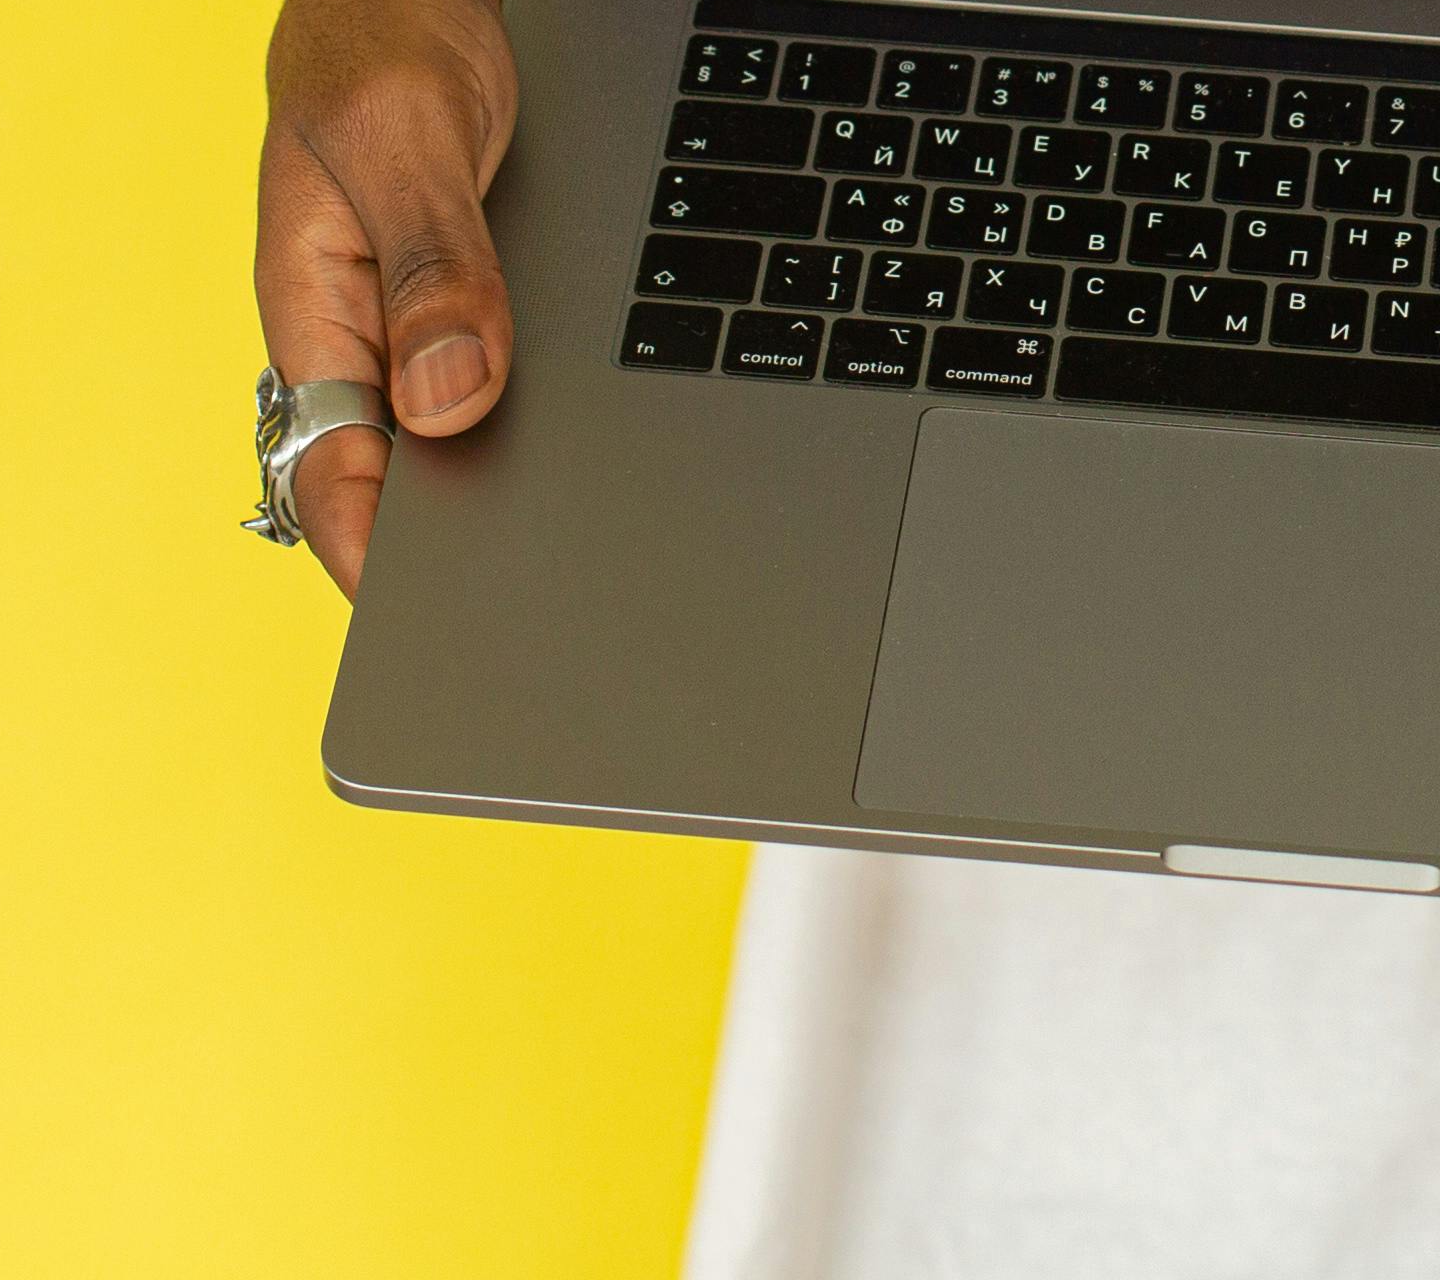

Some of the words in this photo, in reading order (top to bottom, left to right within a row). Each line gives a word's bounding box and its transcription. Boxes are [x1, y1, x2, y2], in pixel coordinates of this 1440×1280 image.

[895, 82, 910, 97] 2
[993, 89, 1008, 105] 3
[1091, 98, 1106, 112] 4
[1191, 105, 1205, 120] 5
[1289, 113, 1304, 128] 6
[1390, 119, 1404, 134] 7
[836, 121, 854, 138] Q
[935, 128, 959, 144] W
[1034, 136, 1049, 152] E
[1133, 143, 1149, 159] R
[874, 146, 893, 165] Й
[1235, 151, 1251, 167] T
[975, 157, 994, 176] Ц
[1335, 159, 1350, 174] Y
[848, 189, 865, 205] A
[948, 197, 964, 213] S
[1047, 205, 1065, 221] D
[1148, 213, 1163, 228] F
[882, 218, 904, 233] Ф
[1249, 221, 1266, 237] G
[984, 226, 1006, 242] Ы
[1349, 229, 1367, 245] H
[1290, 250, 1307, 266] П
[885, 261, 902, 277] Z
[986, 269, 1004, 286] X
[1087, 278, 1104, 294] C
[1190, 285, 1207, 302] V
[926, 292, 943, 307] Я
[1030, 299, 1046, 315] Ч
[1290, 293, 1305, 309] B
[1391, 301, 1409, 317] N
[1331, 324, 1349, 340] И
[637, 343, 654, 354] fn
[741, 353, 803, 366] control
[848, 362, 904, 374] option
[946, 370, 1032, 385] command
